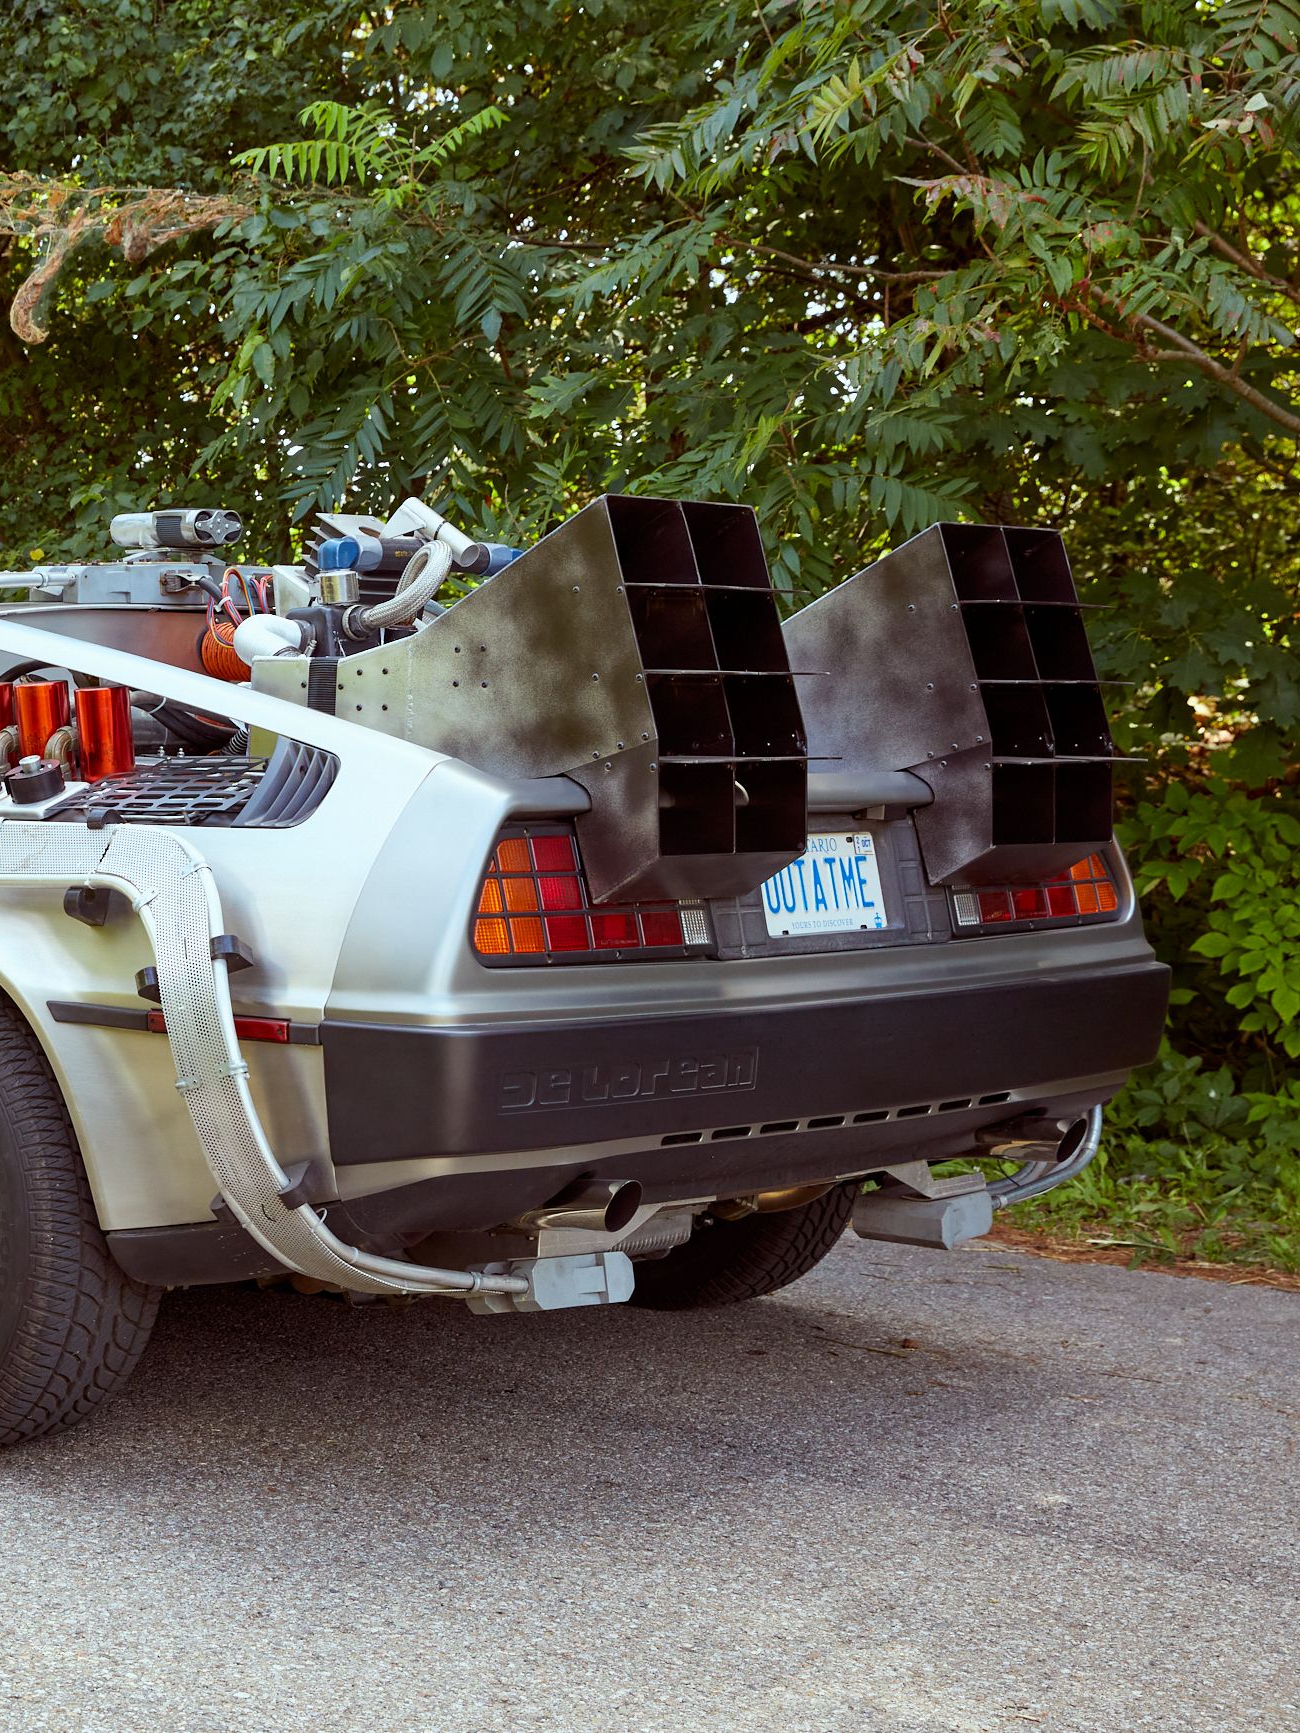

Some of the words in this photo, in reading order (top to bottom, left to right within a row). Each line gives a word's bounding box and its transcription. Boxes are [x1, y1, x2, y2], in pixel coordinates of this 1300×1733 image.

[805, 837, 838, 853] TARIO
[861, 839, 871, 848] OCT
[791, 920, 811, 930] YOURS
[812, 920, 821, 928] TO
[822, 918, 854, 928] DISCOVER
